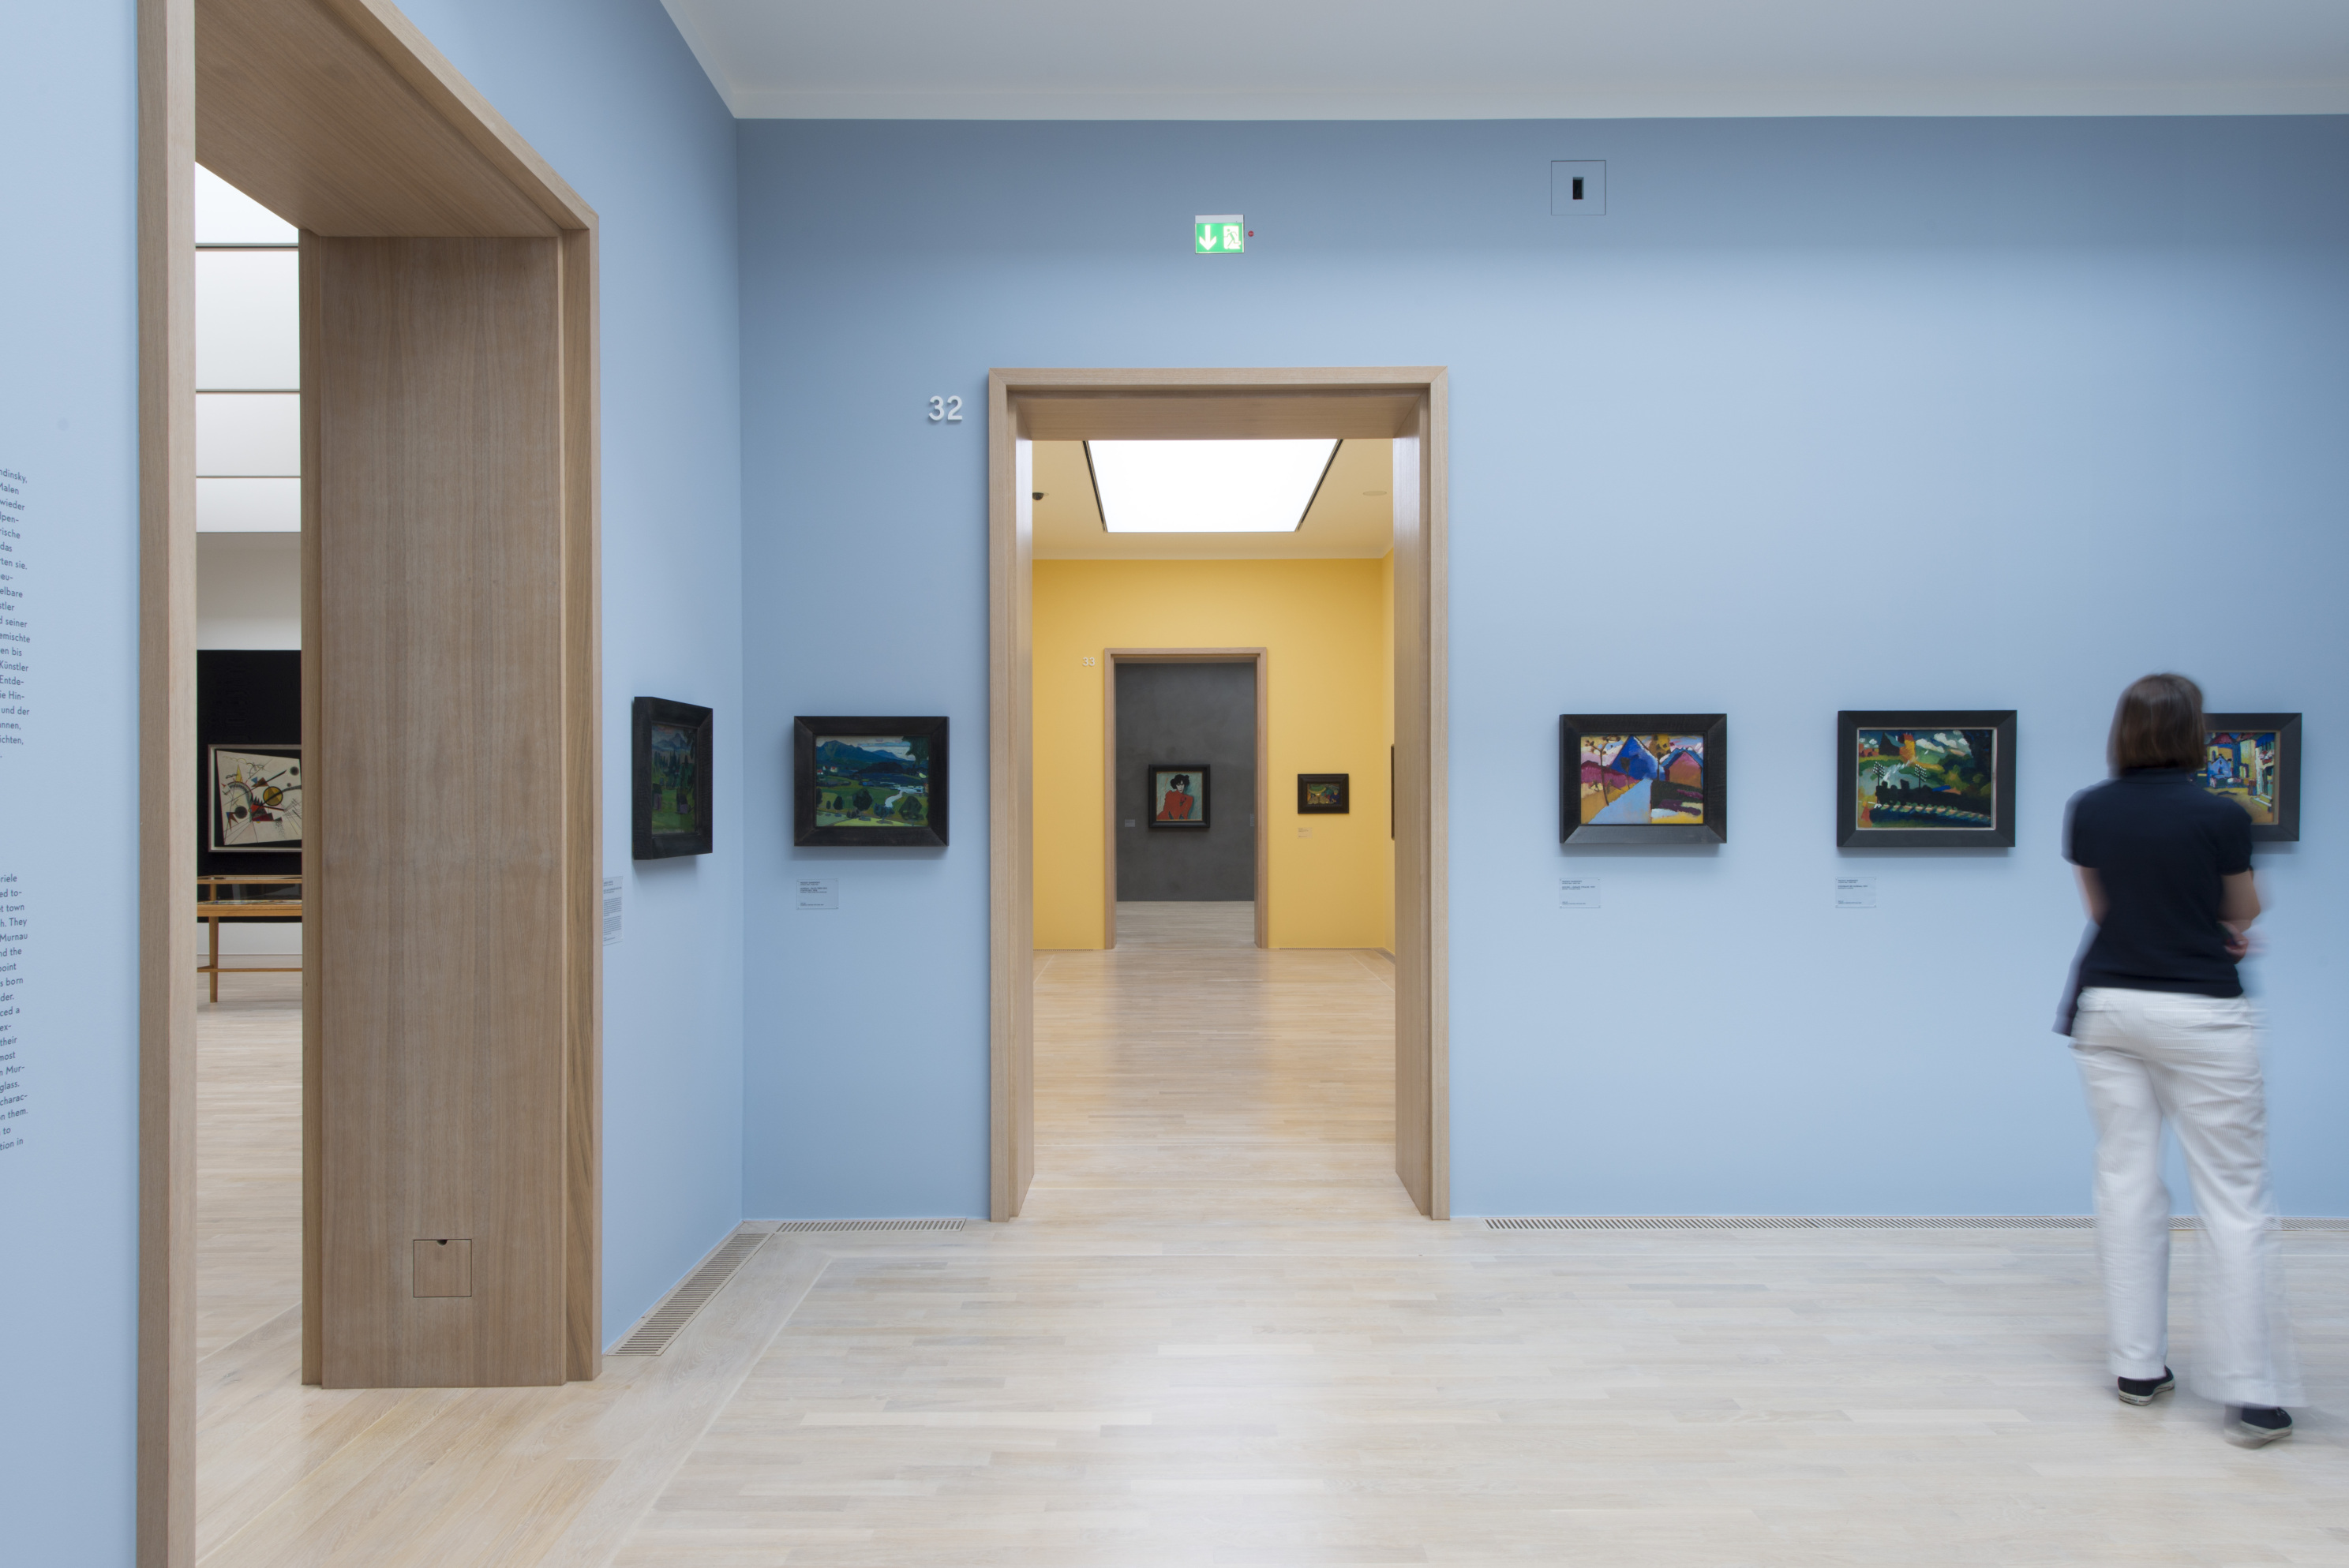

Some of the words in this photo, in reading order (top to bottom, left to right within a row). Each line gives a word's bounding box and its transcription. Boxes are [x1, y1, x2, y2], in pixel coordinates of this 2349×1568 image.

[929, 395, 962, 421] 32
[0, 499, 25, 511] wieder
[0, 541, 12, 552] das
[15, 560, 27, 570] sie.
[0, 586, 23, 597] elbare
[6, 619, 28, 627] seiner
[12, 647, 22, 656] bis
[0, 660, 28, 672] Künstler
[1082, 657, 1096, 667] 33
[0, 675, 24, 685] Entde-
[9, 690, 24, 700] Hin-
[2, 705, 15, 714] und
[17, 706, 30, 715] der
[9, 917, 27, 926] They
[0, 934, 28, 942] Murnau
[9, 947, 22, 956] the
[0, 993, 14, 1001] der.
[0, 1006, 13, 1016] ced
[0, 1036, 17, 1046] their
[6, 1065, 24, 1075] Mur-
[0, 1081, 20, 1093] glass.
[0, 1094, 28, 1106] charac-
[8, 1108, 28, 1119] them.
[0, 1142, 14, 1151] tion
